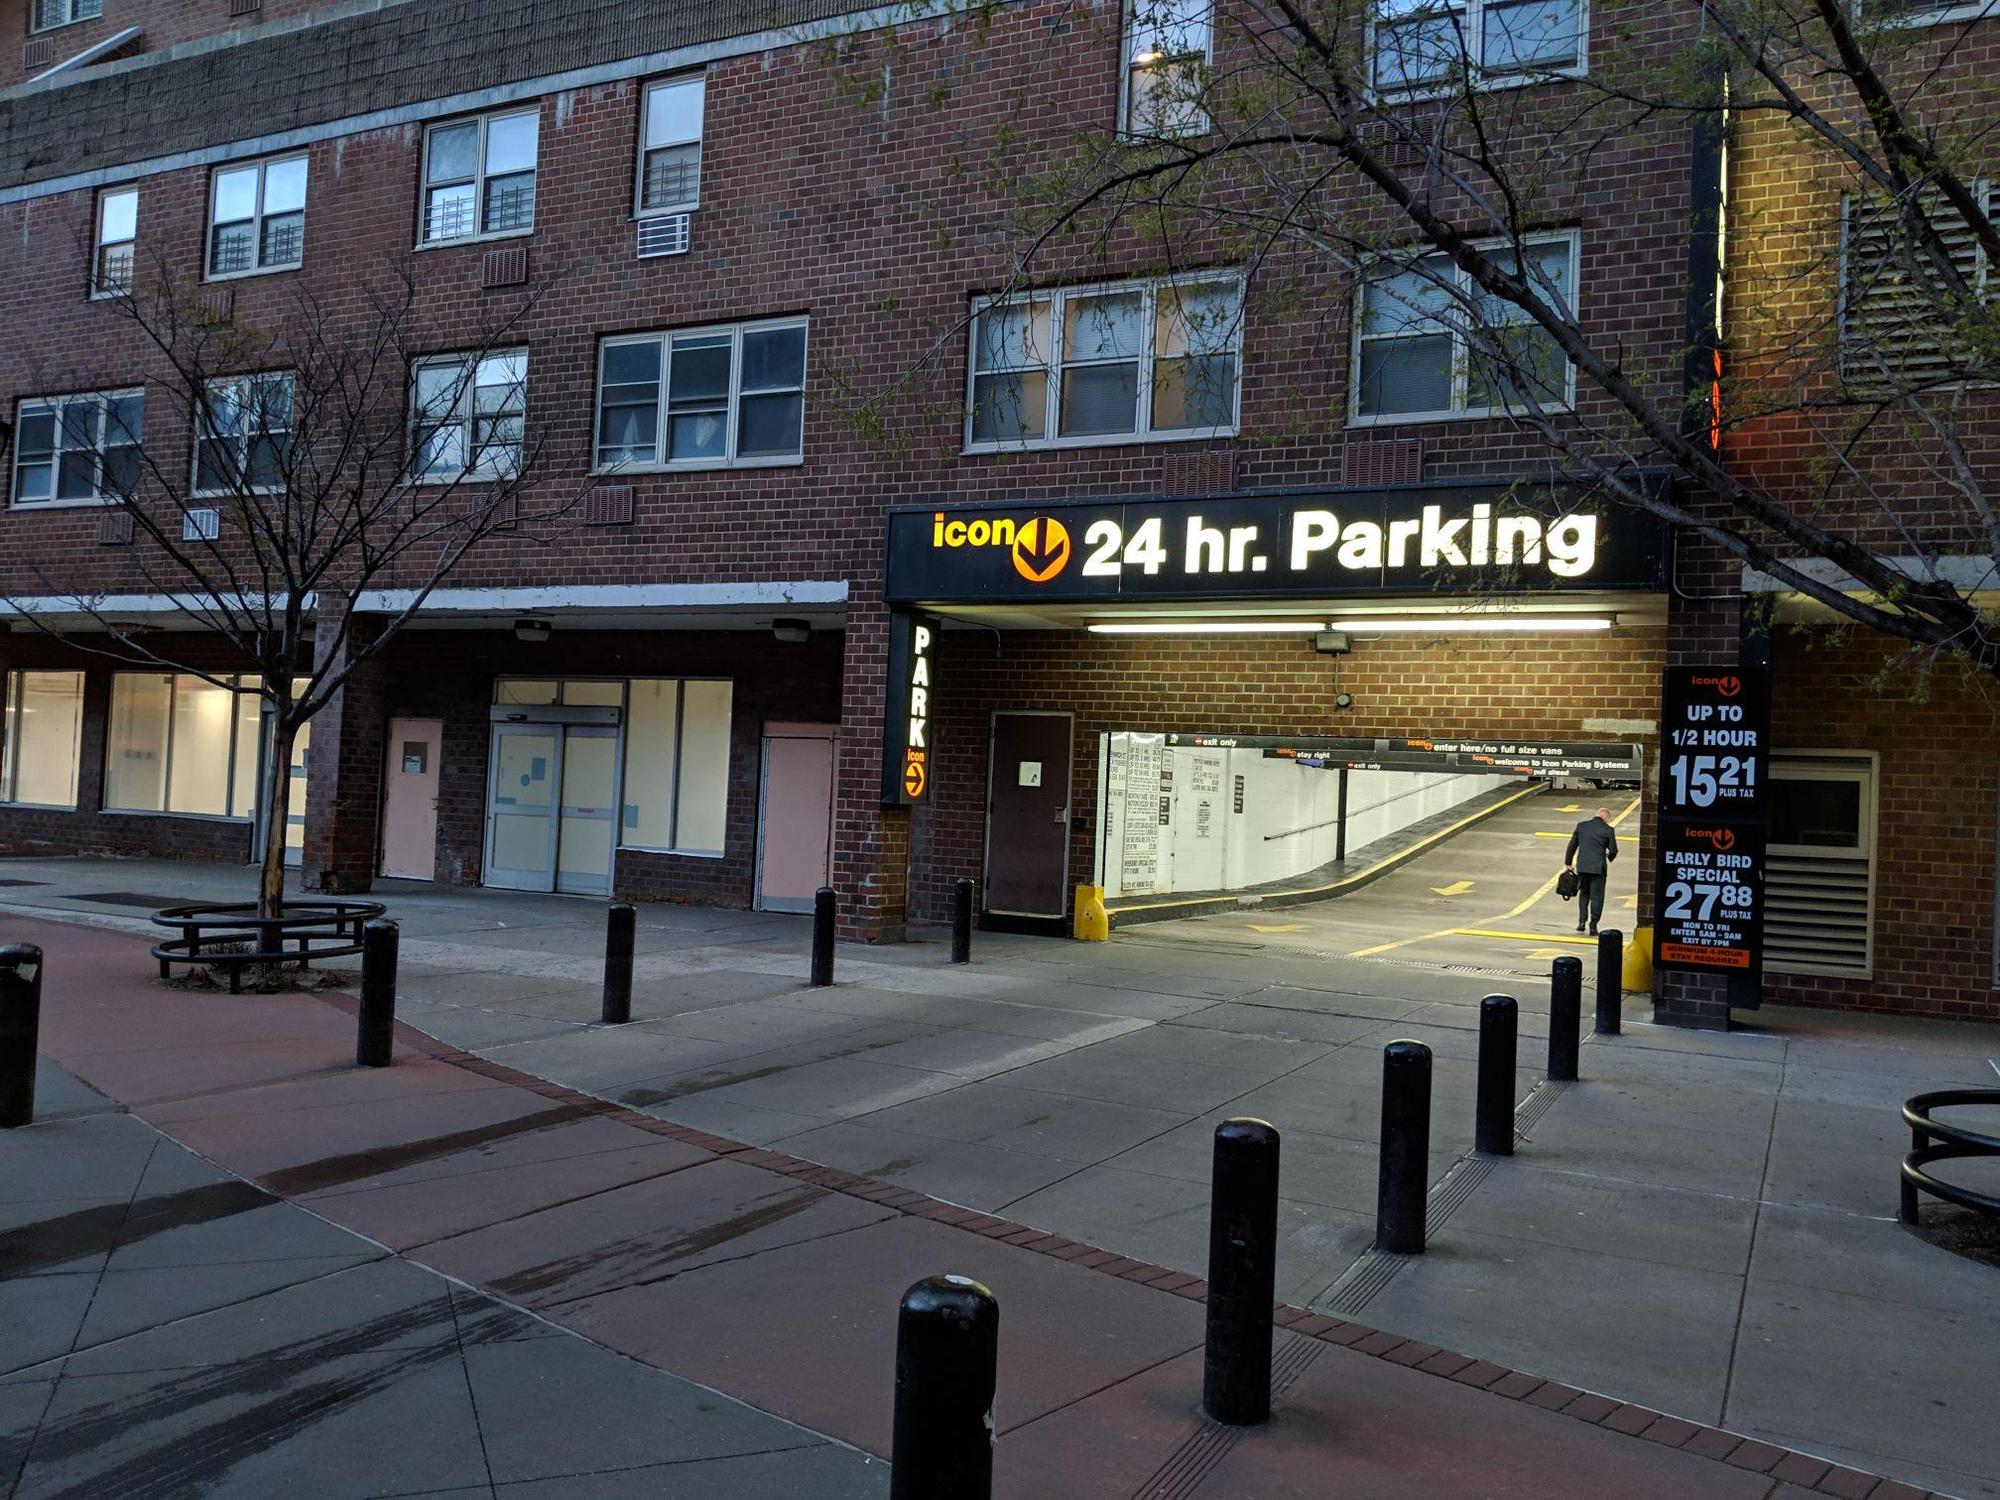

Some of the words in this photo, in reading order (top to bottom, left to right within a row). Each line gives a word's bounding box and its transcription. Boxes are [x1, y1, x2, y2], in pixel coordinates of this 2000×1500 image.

[933, 512, 1015, 548] icon
[1082, 520, 1166, 577] 24
[1184, 516, 1268, 574] hr.
[1291, 503, 1598, 578] Parking
[1691, 675, 1719, 686] icon
[910, 626, 930, 747] PARK
[1687, 704, 1713, 722] UP
[1717, 705, 1743, 722] TO
[1202, 738, 1218, 746] exit
[1219, 738, 1237, 748] only
[1672, 729, 1698, 746] 1/2
[1703, 729, 1757, 747] HOUR
[907, 749, 925, 762] icon
[1297, 751, 1312, 759] stay
[1313, 752, 1330, 760] right
[1433, 744, 1458, 752] enter
[1500, 745, 1516, 754] full
[1518, 746, 1538, 755] size
[1540, 747, 1563, 756] vans
[1494, 758, 1529, 766] welcome
[1531, 759, 1540, 767] to
[1561, 760, 1592, 769] Parking
[1593, 761, 1630, 770] Systems
[1547, 769, 1570, 777] ahead
[1719, 788, 1737, 797] PLUS
[1739, 788, 1754, 798] TAX
[1685, 828, 1713, 838] icon
[1665, 851, 1711, 867] EARLY
[1717, 854, 1752, 868] BIRD
[1677, 868, 1740, 883] SPECIAL
[1720, 910, 1738, 919] PLUS
[1738, 911, 1752, 920] TAX
[1682, 921, 1700, 930] MON
[1703, 923, 1714, 931] TO
[1716, 924, 1730, 932] FRI
[1670, 928, 1696, 937] ENTER
[1682, 937, 1699, 945] EXIT
[1713, 939, 1730, 947] 7PM
